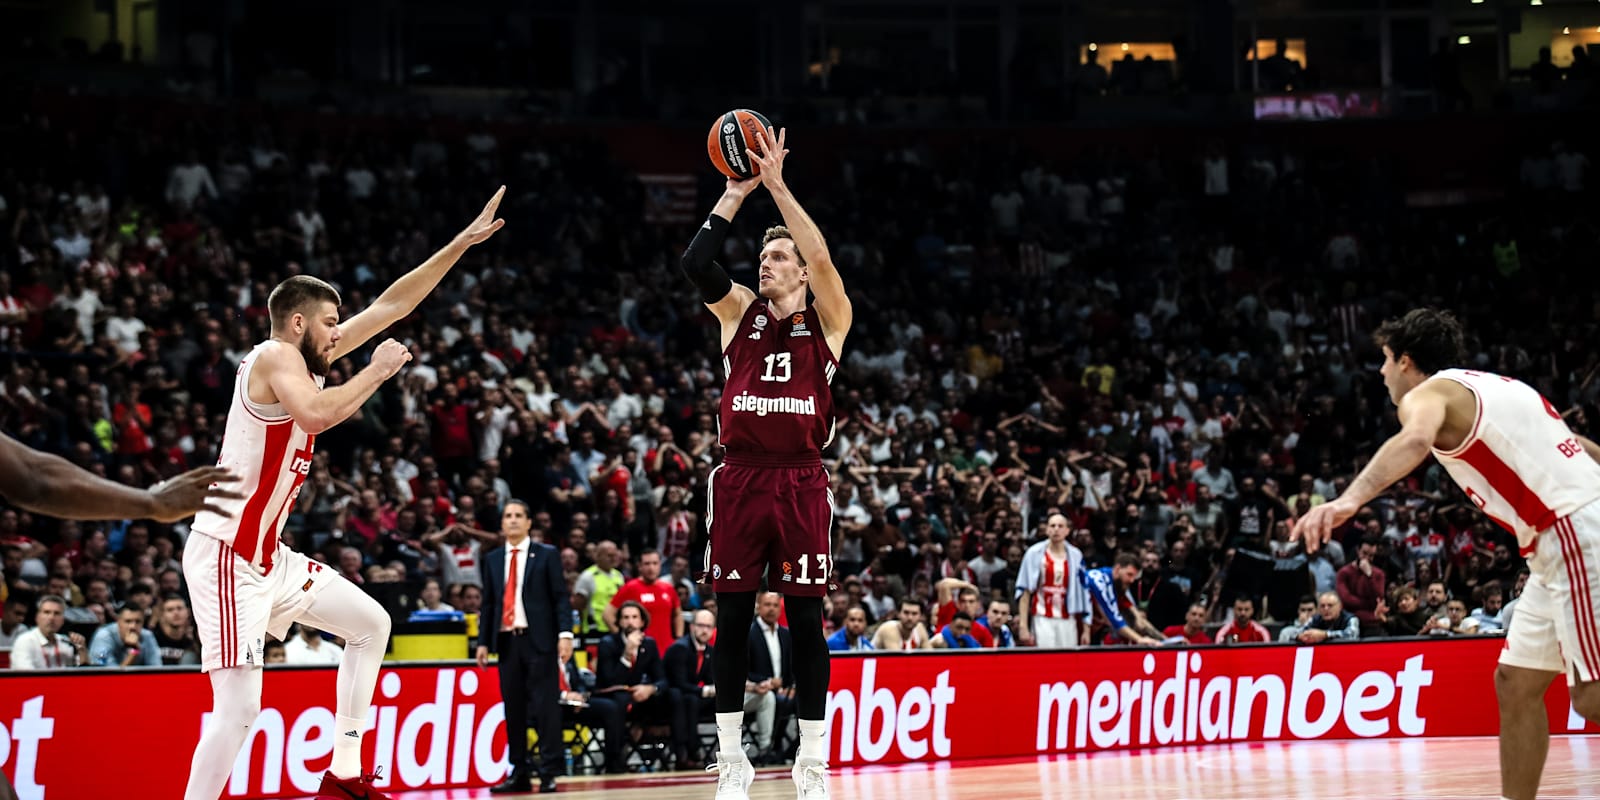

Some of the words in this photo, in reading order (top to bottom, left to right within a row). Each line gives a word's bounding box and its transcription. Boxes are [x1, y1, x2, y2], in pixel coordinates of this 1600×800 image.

[760, 352, 791, 382] 13
[732, 391, 815, 416] siegmund
[1556, 437, 1582, 458] BE
[796, 554, 828, 584] 13
[1036, 647, 1433, 750] meridianbet
